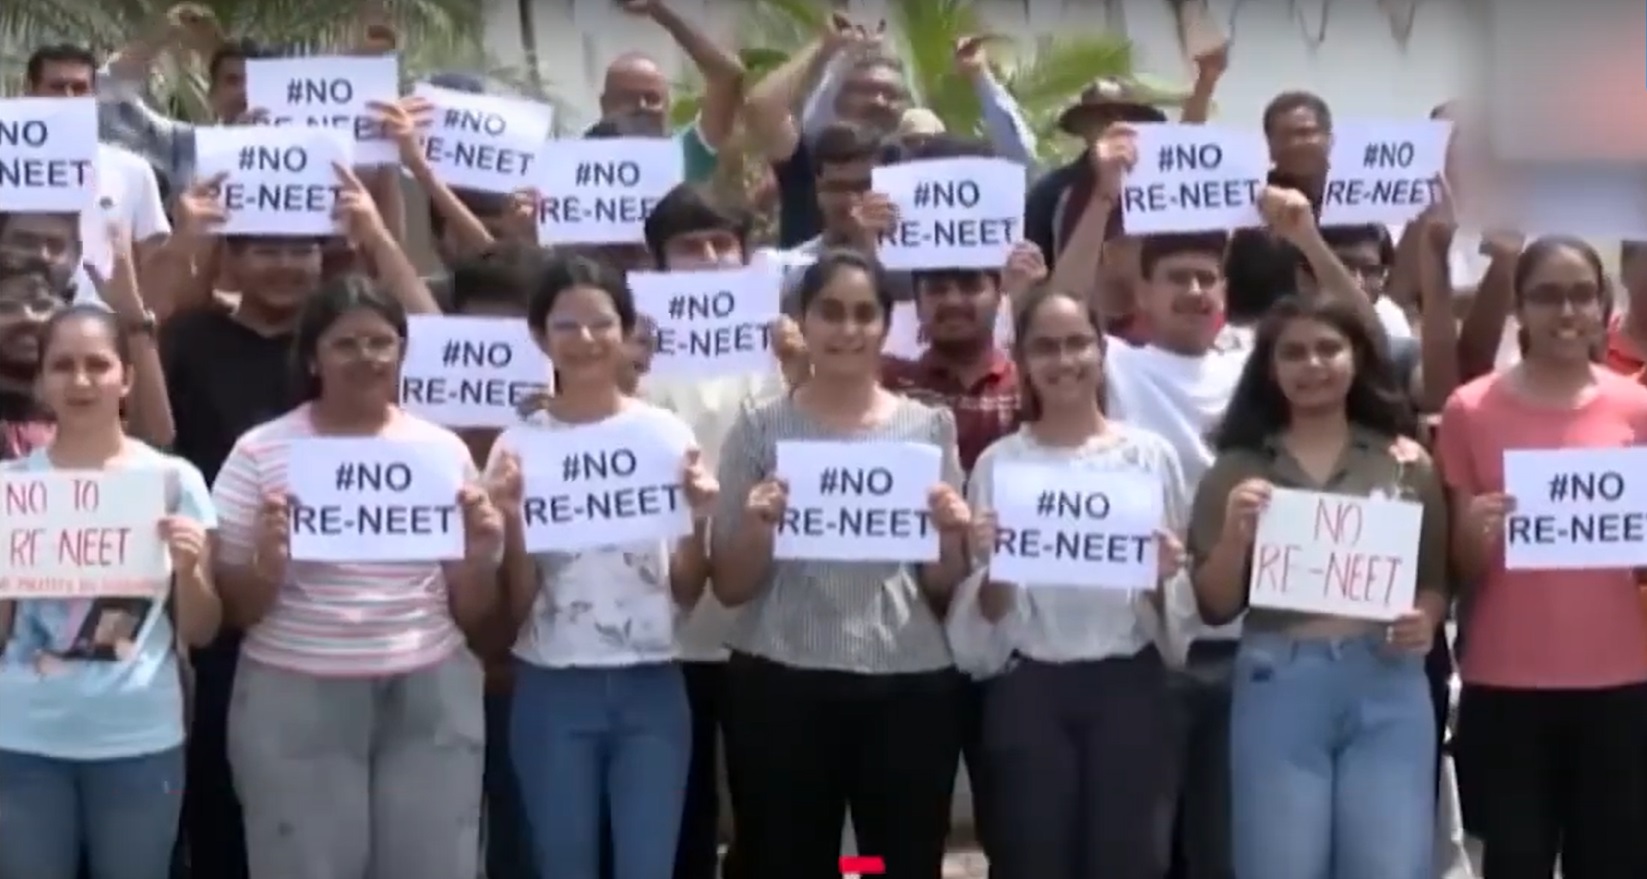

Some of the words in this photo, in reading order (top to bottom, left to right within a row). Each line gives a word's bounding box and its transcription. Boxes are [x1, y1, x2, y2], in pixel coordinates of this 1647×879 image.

[287, 78, 353, 104] #NO
[444, 108, 507, 137] #NO
[239, 145, 308, 172] #NO
[421, 136, 535, 176] E-NEET
[1158, 143, 1223, 172] #NO
[1363, 140, 1415, 168] #NO
[576, 160, 641, 188] #NO
[212, 183, 342, 212] E-NEET
[913, 179, 980, 208] #NO
[1125, 178, 1260, 213] RE-NEET
[1325, 177, 1438, 206] RE-NEET
[540, 195, 661, 223] RE-NEE
[669, 289, 735, 320] #NO
[442, 339, 512, 367] #NO
[656, 322, 770, 358] E-NEET
[402, 375, 549, 407] RE-NEE
[336, 461, 412, 492] #NO
[563, 448, 637, 482] #NO
[6, 480, 47, 516] NO
[71, 478, 99, 512] TO
[820, 467, 893, 496] #NO
[1548, 471, 1625, 502] #NO
[293, 504, 456, 535] RE-NEET
[524, 484, 681, 527] RE-NEET
[1037, 490, 1110, 520] #NO
[778, 506, 931, 538] RE-NEET
[1314, 498, 1363, 547] NO
[1509, 512, 1647, 545] RE-NEE
[58, 526, 132, 567] NEET
[994, 526, 1151, 564] RE-NEET
